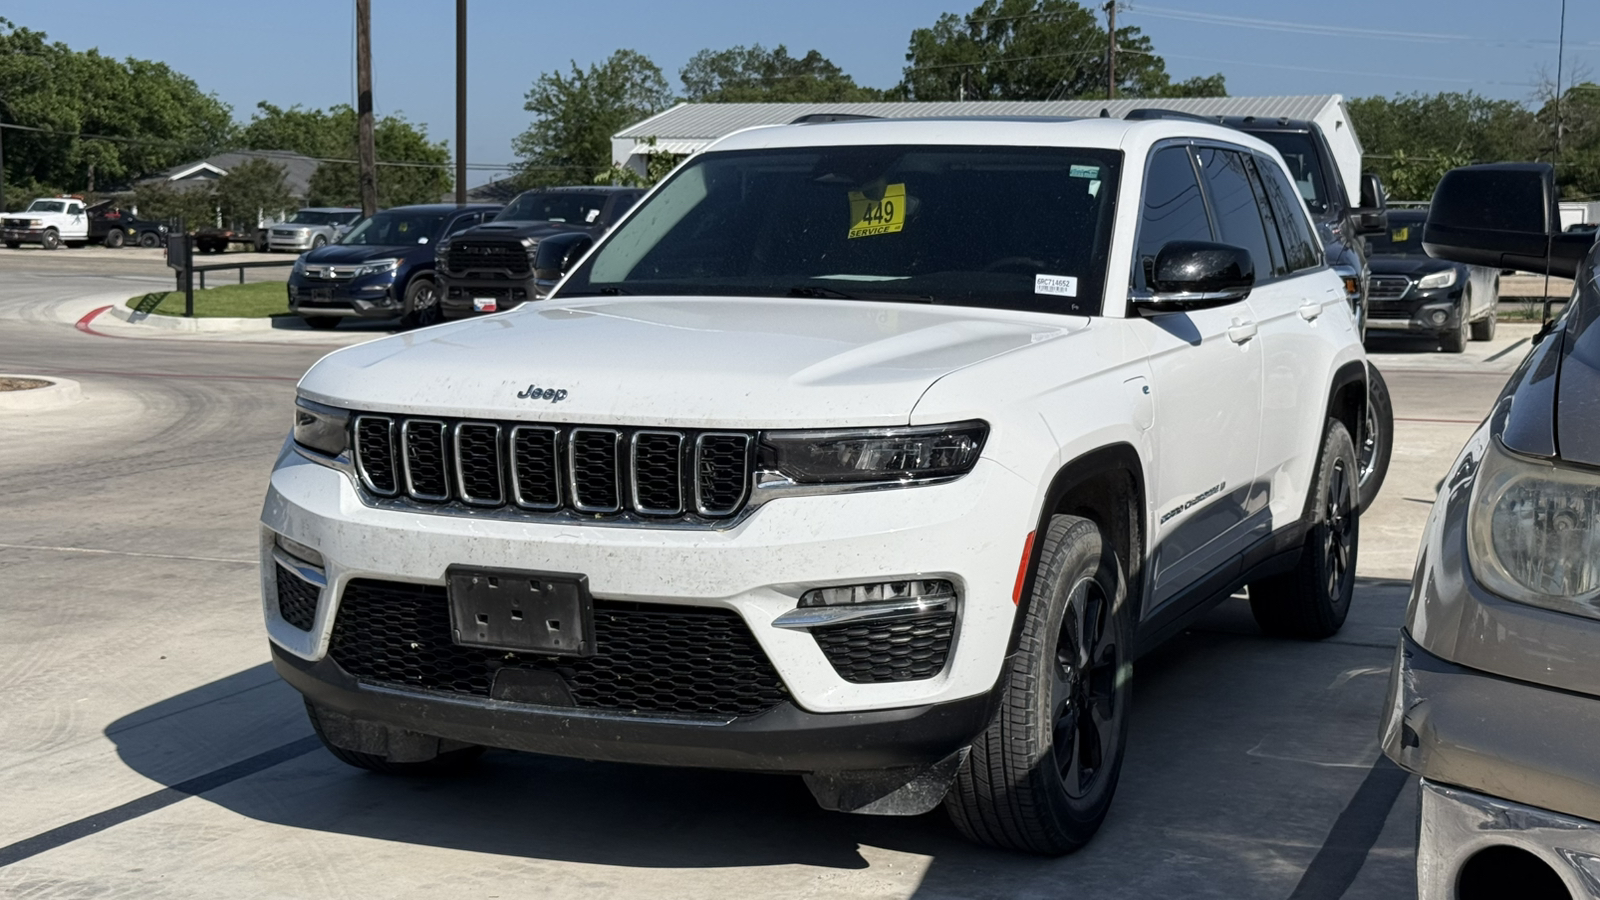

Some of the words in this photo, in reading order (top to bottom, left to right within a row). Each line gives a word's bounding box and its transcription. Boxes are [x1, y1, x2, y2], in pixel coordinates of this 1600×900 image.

[863, 200, 894, 225] 449
[850, 226, 890, 237] SERVICE
[516, 384, 568, 403] Jeep
